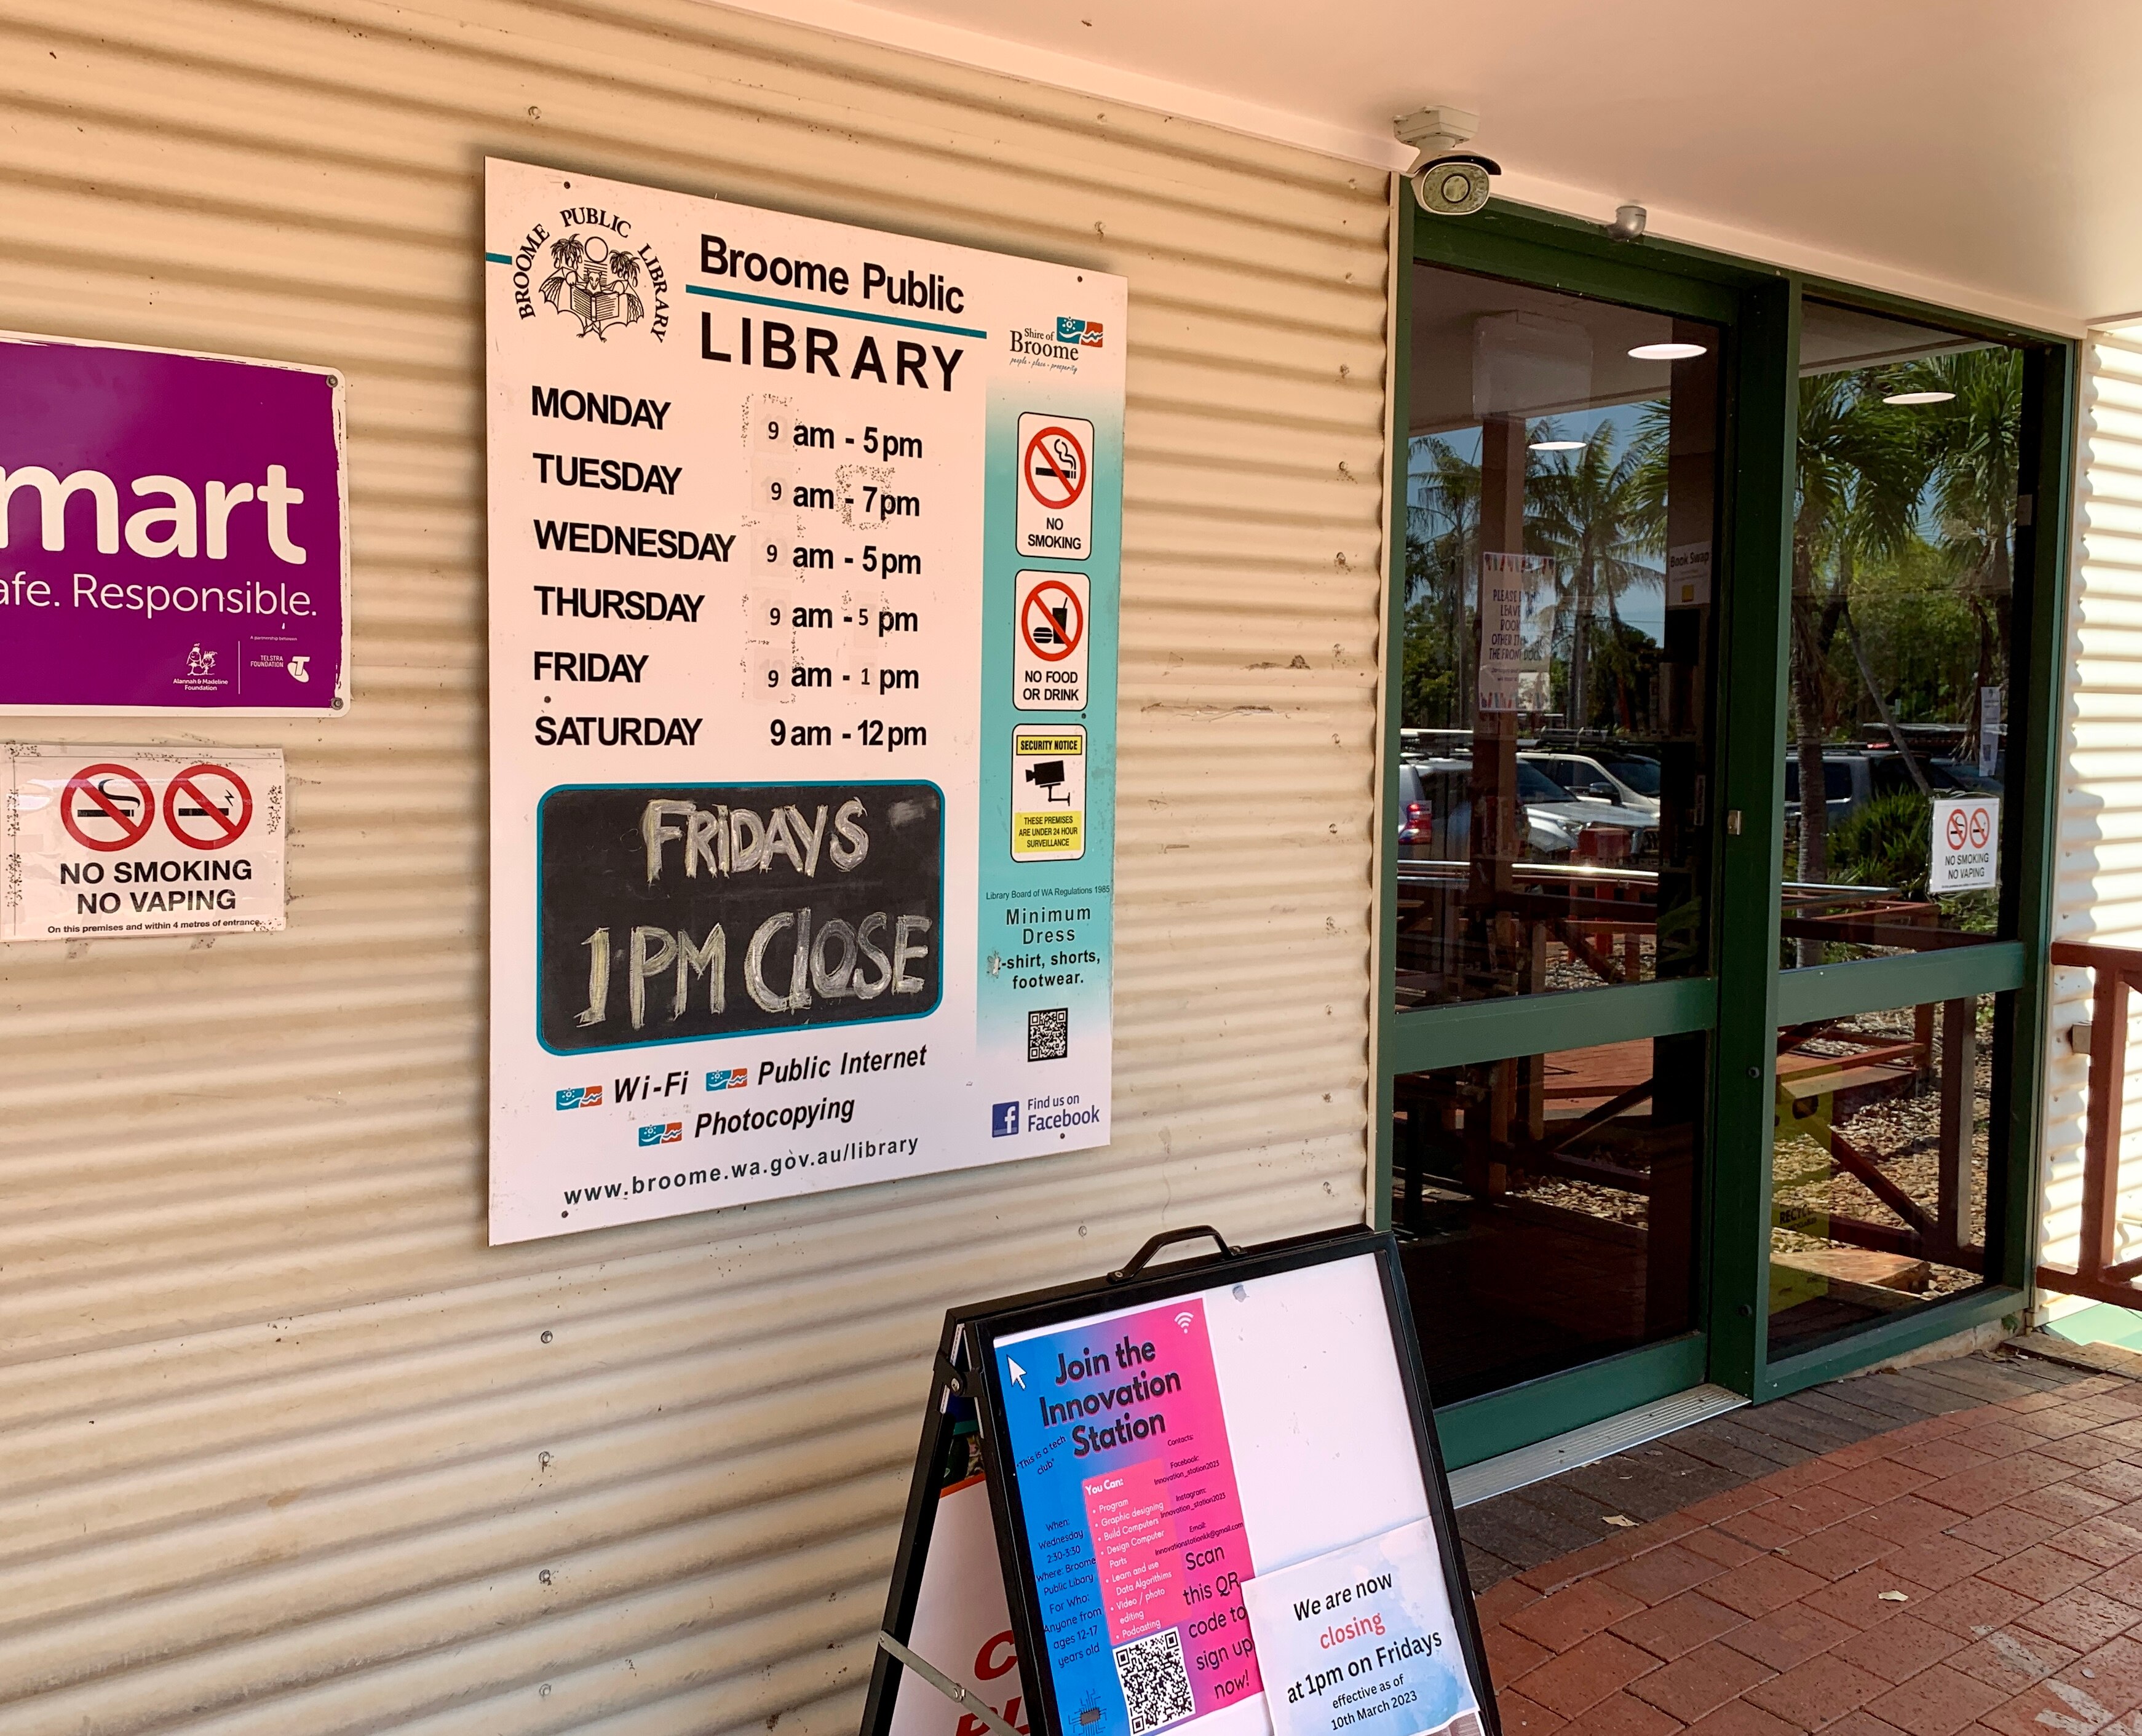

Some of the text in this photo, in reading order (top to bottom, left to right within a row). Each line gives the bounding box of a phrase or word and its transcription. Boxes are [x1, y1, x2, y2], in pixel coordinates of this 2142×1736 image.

[514, 207, 669, 343] BROOME PUBLIC LIBRARY
[700, 235, 964, 315] Broome Public
[1010, 330, 1079, 360] Broome
[1025, 328, 1055, 341] Shire of
[700, 312, 964, 392] LIBRARY
[531, 386, 671, 430] MONDAY
[533, 453, 683, 494] TUESDAY
[1047, 518, 1063, 530] NO
[534, 520, 736, 562] WEDNESDAY
[1028, 534, 1081, 549] SMOKING
[1671, 552, 1708, 568] Book Swap
[73, 573, 317, 619] Responsible.
[534, 585, 705, 622] THURSDAY
[1493, 589, 1517, 601] PLEASE
[1492, 633, 1512, 645] OTHER
[1489, 648, 1521, 659] THE FRONT
[534, 651, 649, 683] FRIDAY
[1025, 670, 1077, 683] NO FOOD
[1023, 688, 1079, 700] OR DRINK
[535, 716, 703, 746] SATURDAY
[1021, 740, 1077, 750] SECURITY NOTICE
[1027, 839, 1069, 847] SURVEILLANCE
[1945, 853, 1989, 866] NO SMOKING
[61, 859, 252, 884] NO SMOKING
[1948, 867, 1985, 879] NO VAPING
[77, 889, 236, 914] NO VAPING
[1055, 886, 1092, 897] Regulations
[63, 924, 80, 933] this
[82, 922, 123, 933] premises
[145, 921, 170, 930] within
[181, 920, 210, 929] metres
[1006, 907, 1090, 925] Minimum
[1023, 929, 1075, 945] Dress
[1051, 949, 1100, 965] shorts,
[1013, 973, 1084, 989] footwear.
[613, 1044, 927, 1104] Wi-Fi Public Internet
[1028, 1095, 1079, 1110] Find us on
[694, 1097, 855, 1137] Photocopying
[1028, 1104, 1100, 1132] Facebook
[563, 1135, 918, 1205] www.broome.wa.gov.au/library
[1055, 1335, 1156, 1386] Join the
[1039, 1370, 1182, 1428] Innovation
[1049, 1435, 1066, 1449] tech
[1072, 1413, 1166, 1458] Station
[1167, 1434, 1194, 1446] Contacts:
[1170, 1456, 1199, 1468] Facebook:
[1085, 1478, 1124, 1496] You Can:
[1176, 1488, 1206, 1502] Instagram:
[1099, 1499, 1129, 1513] Program
[1101, 1502, 1164, 1526] Graphic designing
[1046, 1518, 1070, 1531] When:
[1104, 1518, 1159, 1540] Build Computers
[1189, 1522, 1206, 1532] Email:
[1038, 1530, 1084, 1550] Wednesday
[1107, 1530, 1164, 1555] Design Computer
[1047, 1545, 1081, 1563] 2:30-3:30
[1109, 1557, 1127, 1568] Parts
[1186, 1546, 1225, 1571] Scan
[1036, 1557, 1096, 1582] Where: Broome
[1112, 1572, 1132, 1582] Learn
[1133, 1563, 1146, 1575] and
[1044, 1574, 1093, 1595] Public Libary
[1116, 1584, 1134, 1596] Data
[1183, 1572, 1240, 1606] this QR
[1050, 1594, 1089, 1614] For Who:
[1116, 1588, 1165, 1610] Video photo
[1293, 1572, 1393, 1621] We are now
[1045, 1607, 1102, 1633] Anyone from
[1120, 1611, 1144, 1624] editing
[1189, 1606, 1247, 1638] code to
[1053, 1625, 1098, 1649] ages 12-17
[1122, 1620, 1160, 1638] Podcasting
[1320, 1612, 1386, 1649] closing
[1058, 1643, 1100, 1668] years old
[1196, 1638, 1253, 1670] sign up
[1287, 1632, 1442, 1703] at 1pm on Fridays
[1214, 1669, 1250, 1699] now!
[1332, 1673, 1404, 1709] effective as of
[1331, 1690, 1418, 1730] 10th March 2023
